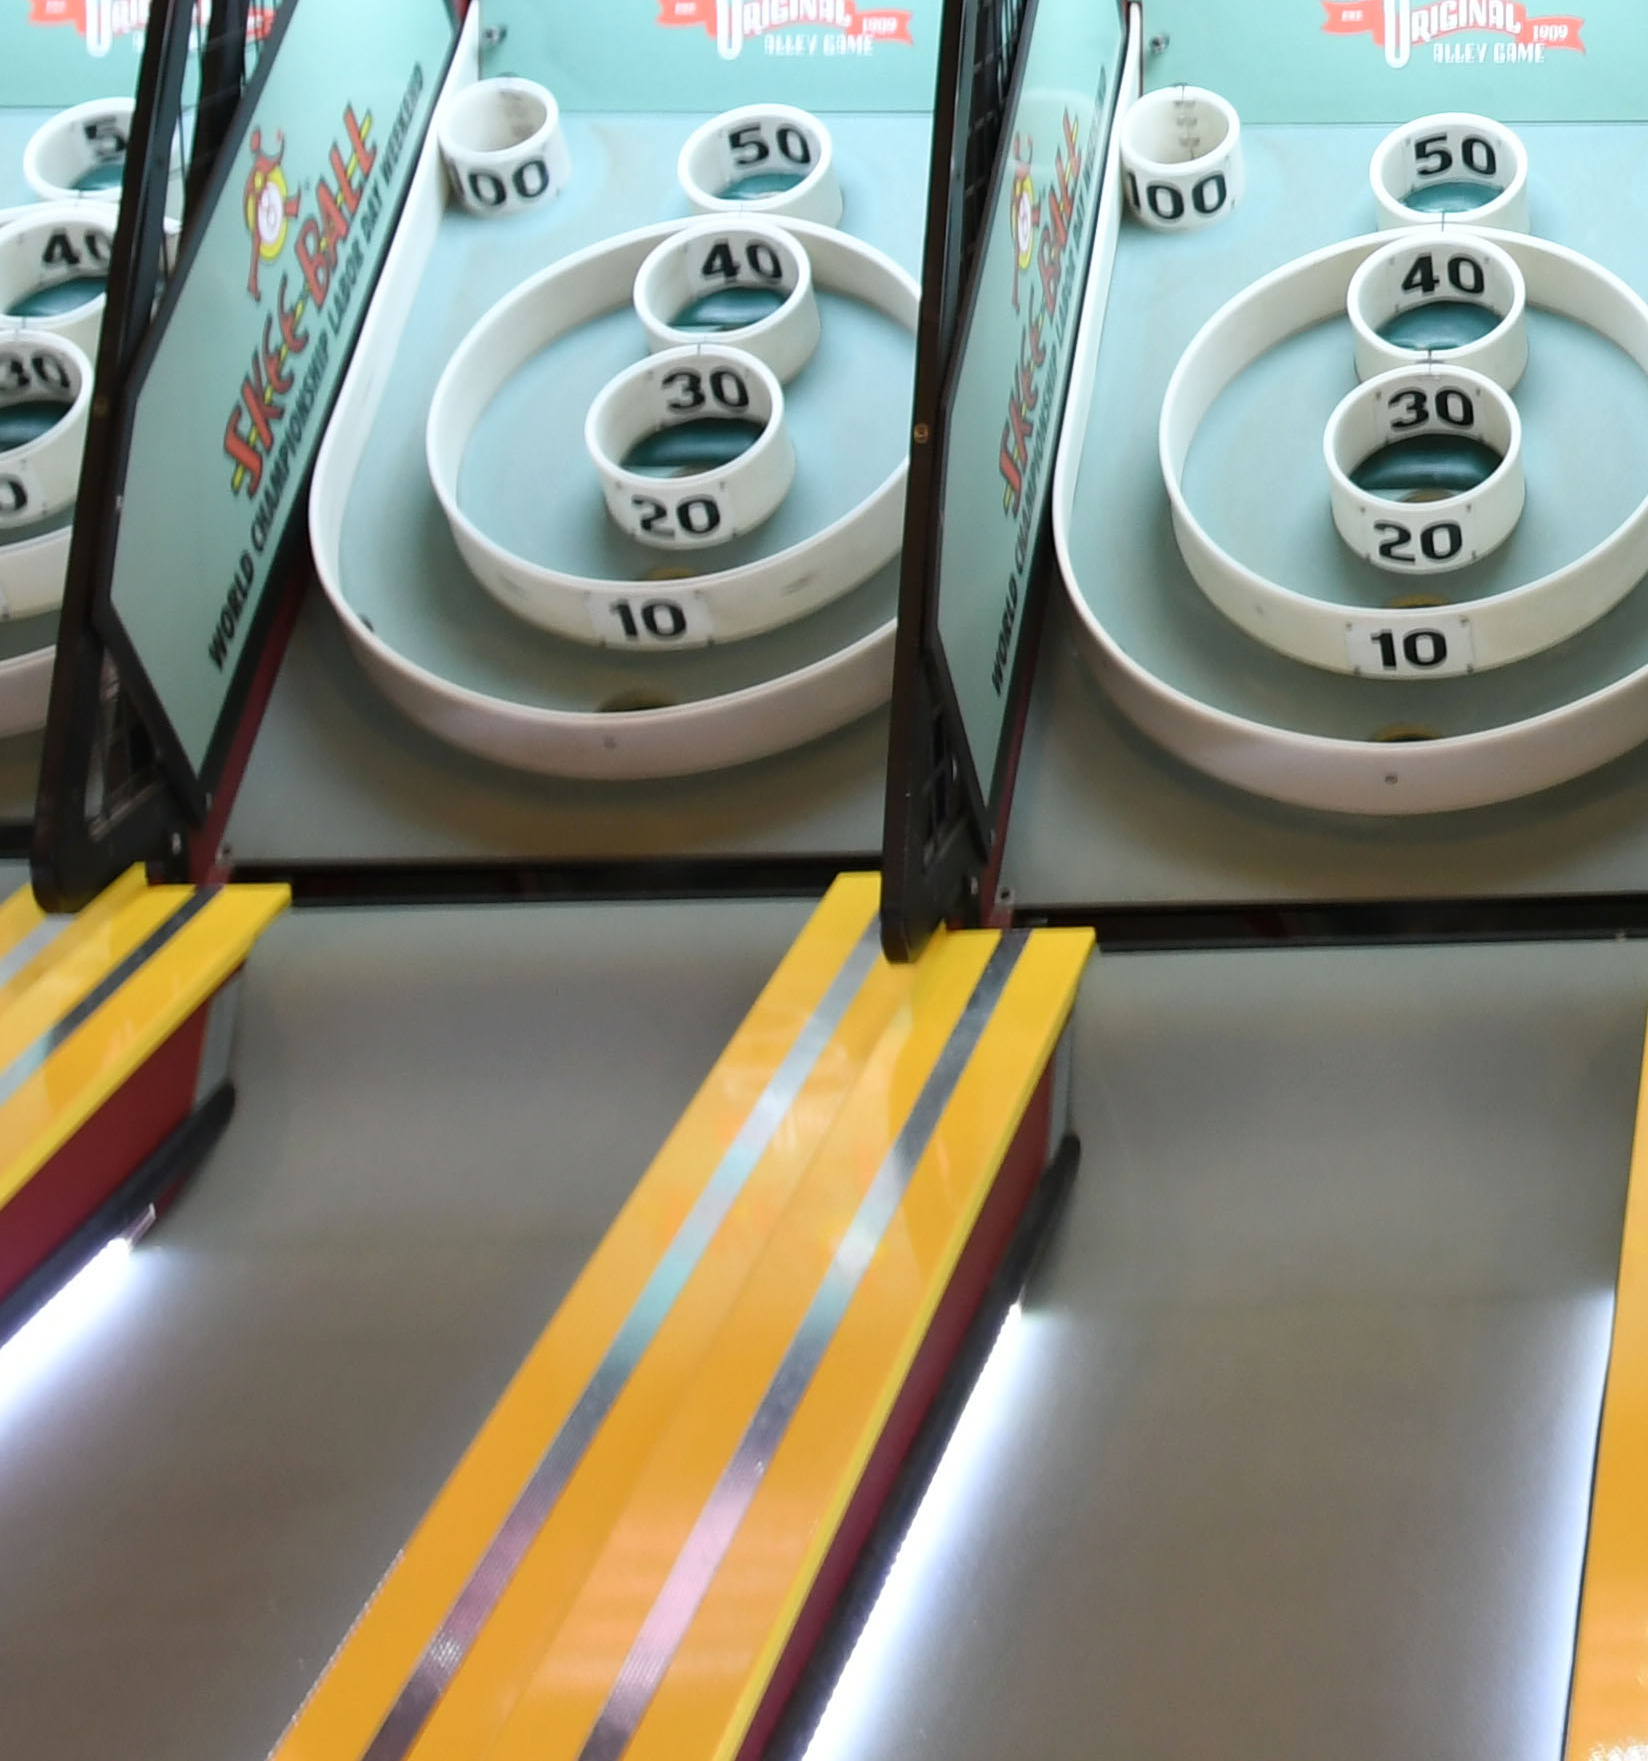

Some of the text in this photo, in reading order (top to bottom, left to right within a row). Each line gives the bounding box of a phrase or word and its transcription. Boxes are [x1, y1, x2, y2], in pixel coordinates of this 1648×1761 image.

[764, 35, 874, 57] ALLEY GAME
[861, 17, 897, 36] 1909
[1533, 24, 1569, 42] 1909
[1433, 42, 1545, 64] ALLEY GAME
[728, 125, 811, 167] 50
[1414, 133, 1498, 176] 50
[1126, 170, 1228, 220] 100
[701, 243, 782, 283] 40
[1401, 254, 1485, 295] 40
[661, 369, 751, 414] 30
[1388, 388, 1475, 429] 30
[208, 550, 255, 673] WORLD
[249, 343, 331, 553] CHAMPIONSHIP
[327, 240, 365, 340] LABOR
[632, 493, 721, 538] 20
[1374, 520, 1463, 562] 20
[609, 597, 687, 639] 10
[990, 586, 1017, 695] WORLD
[1371, 629, 1448, 670] 10
